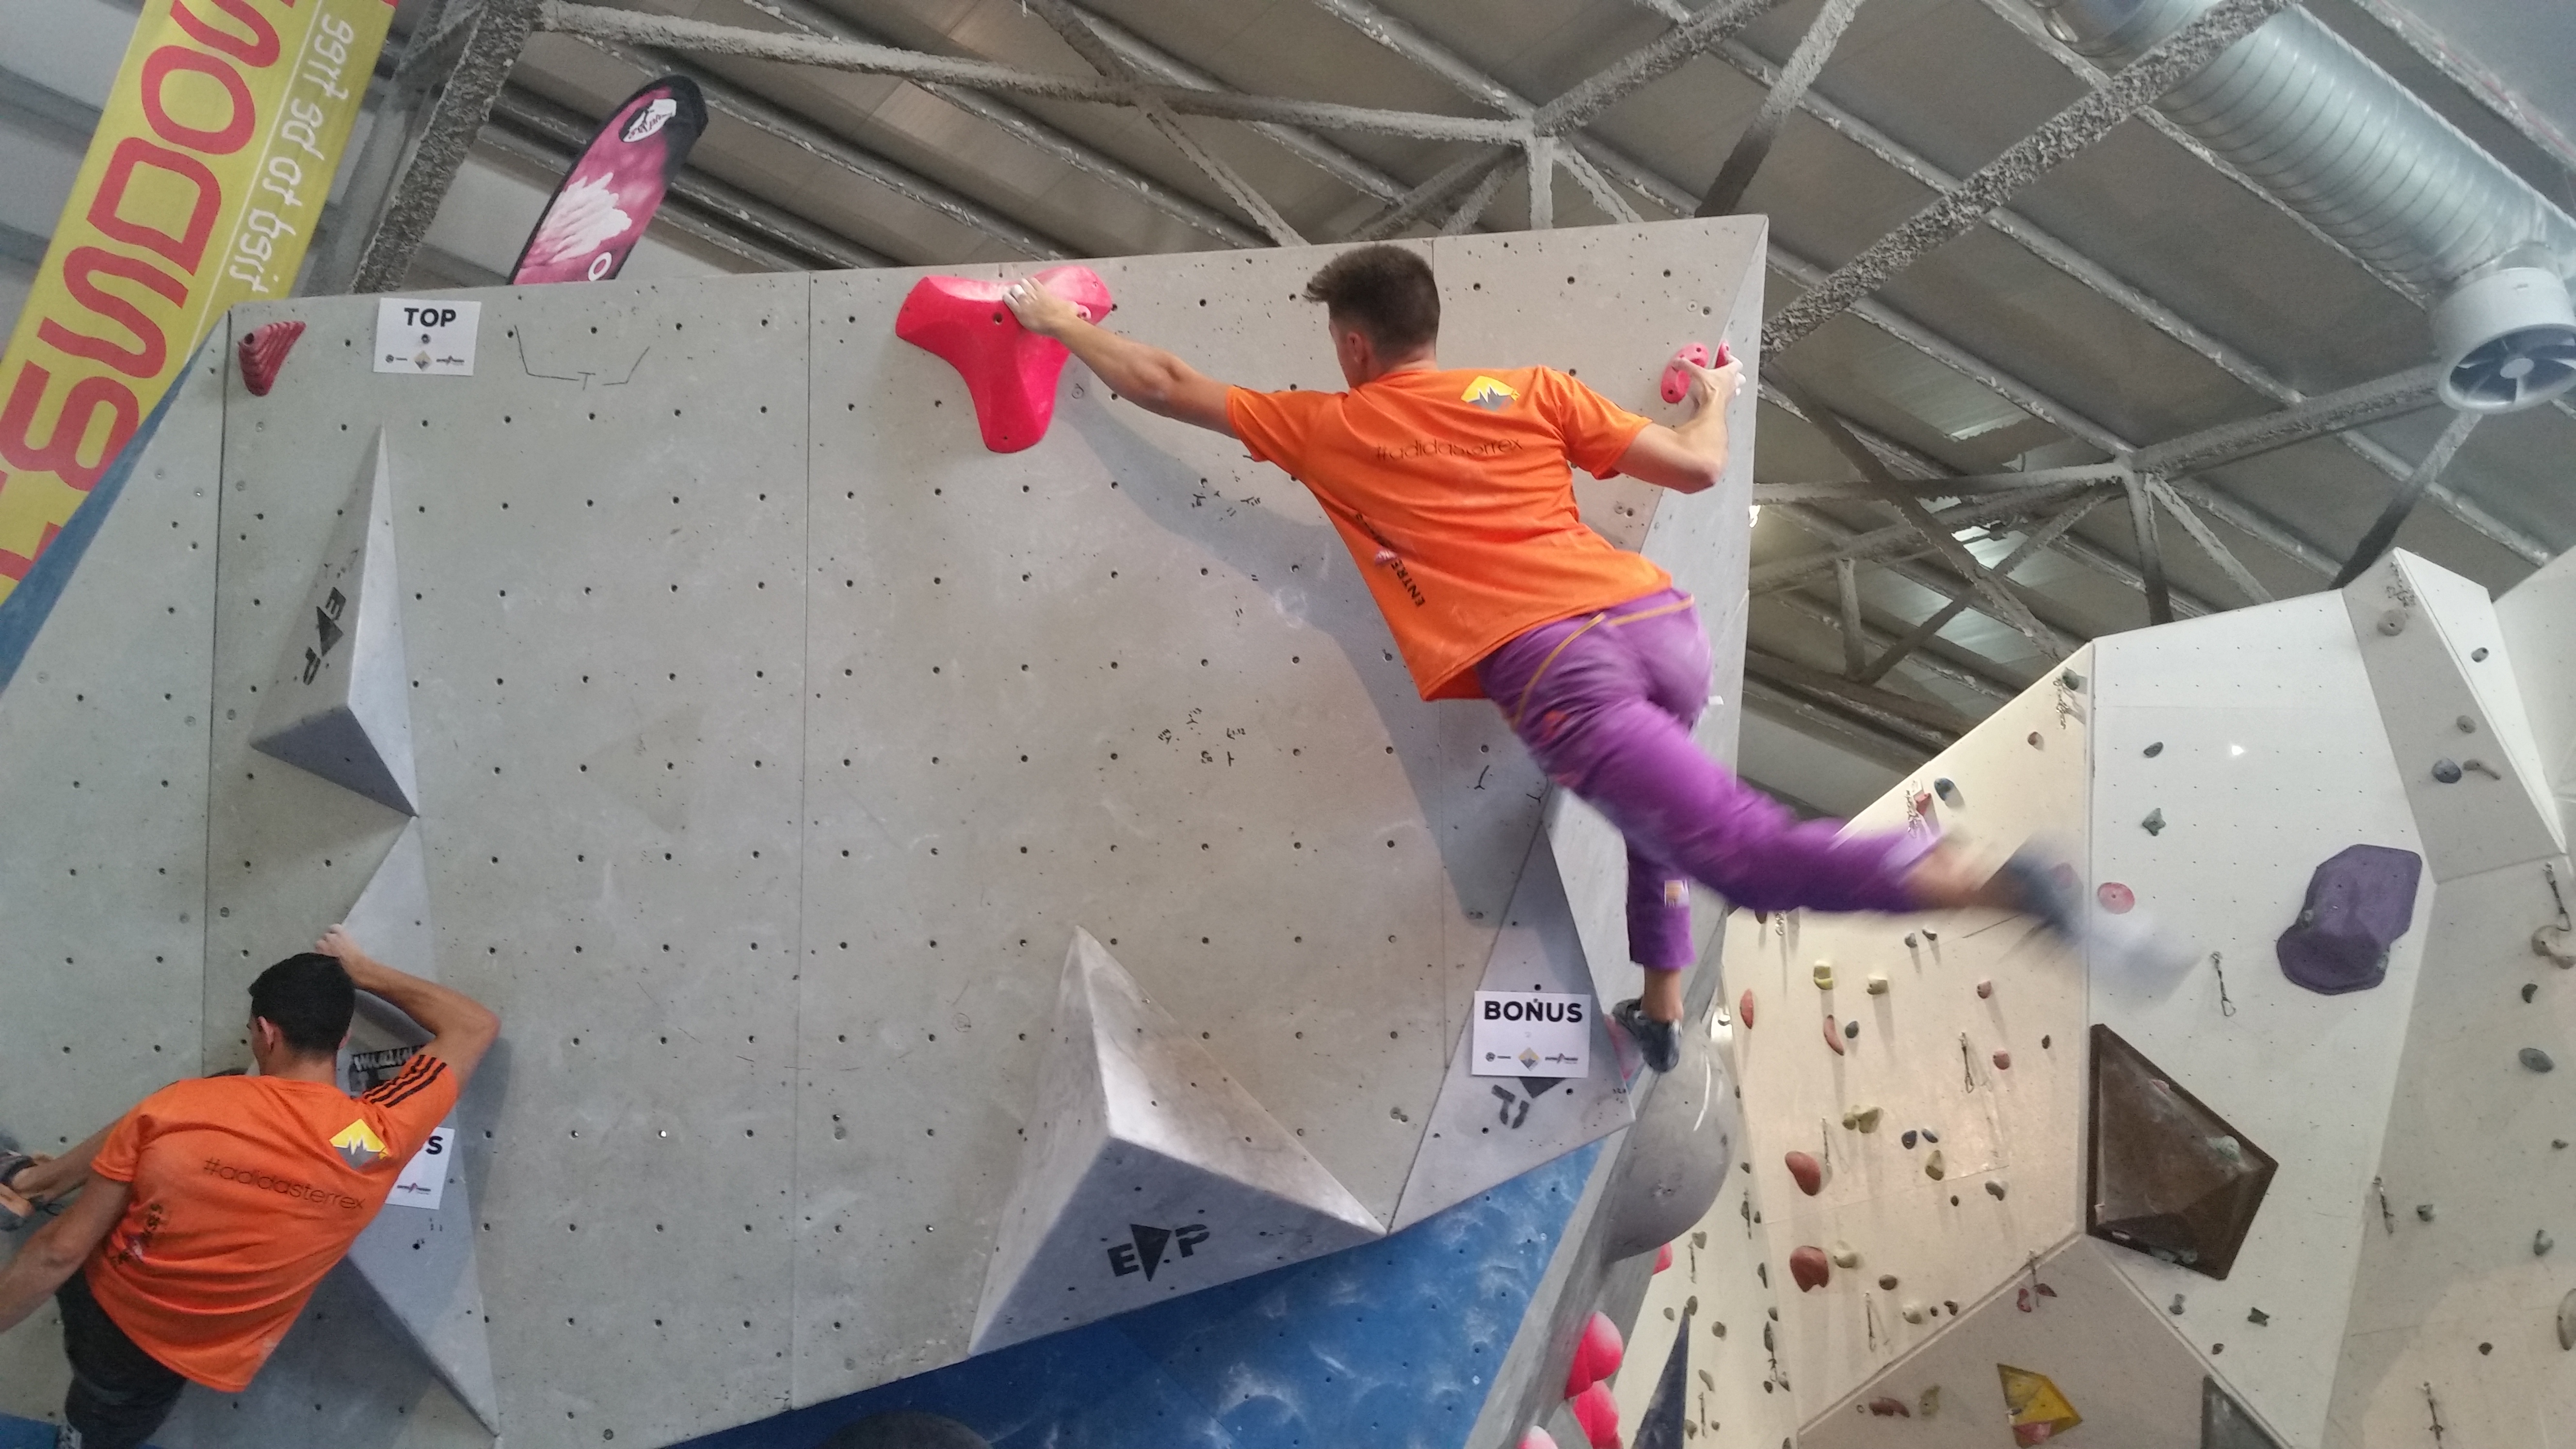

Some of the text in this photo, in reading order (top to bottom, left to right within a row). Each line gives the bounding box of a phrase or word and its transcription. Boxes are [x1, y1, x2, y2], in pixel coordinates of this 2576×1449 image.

[404, 307, 456, 327] TOP
[1484, 1000, 1583, 1023] BONUS
[203, 1156, 366, 1210] #adidasterrex
